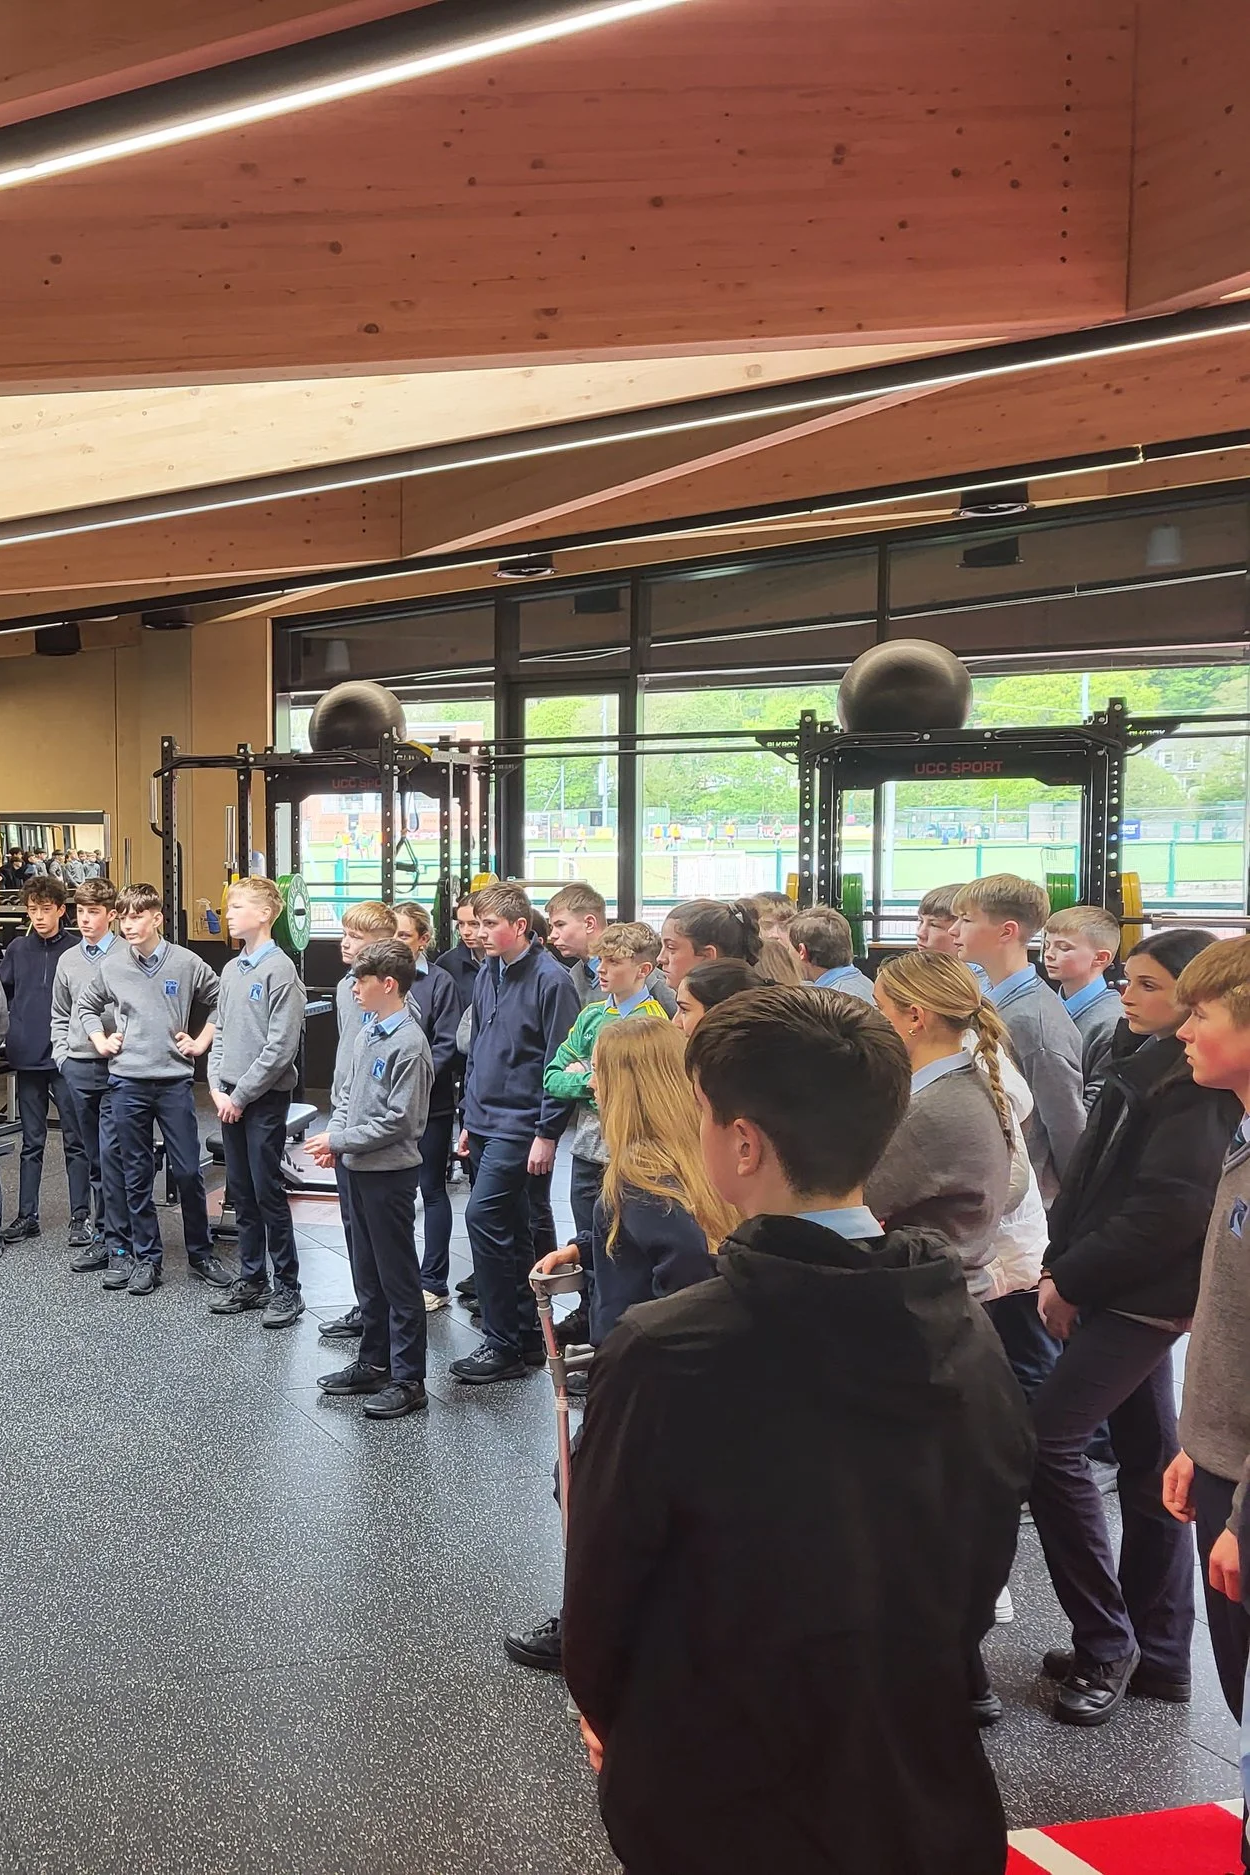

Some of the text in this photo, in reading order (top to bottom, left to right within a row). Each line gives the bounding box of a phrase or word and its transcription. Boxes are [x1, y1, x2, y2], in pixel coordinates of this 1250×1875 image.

[914, 760, 1004, 775] UCC SPORT
[332, 777, 382, 789] UCC SPO
